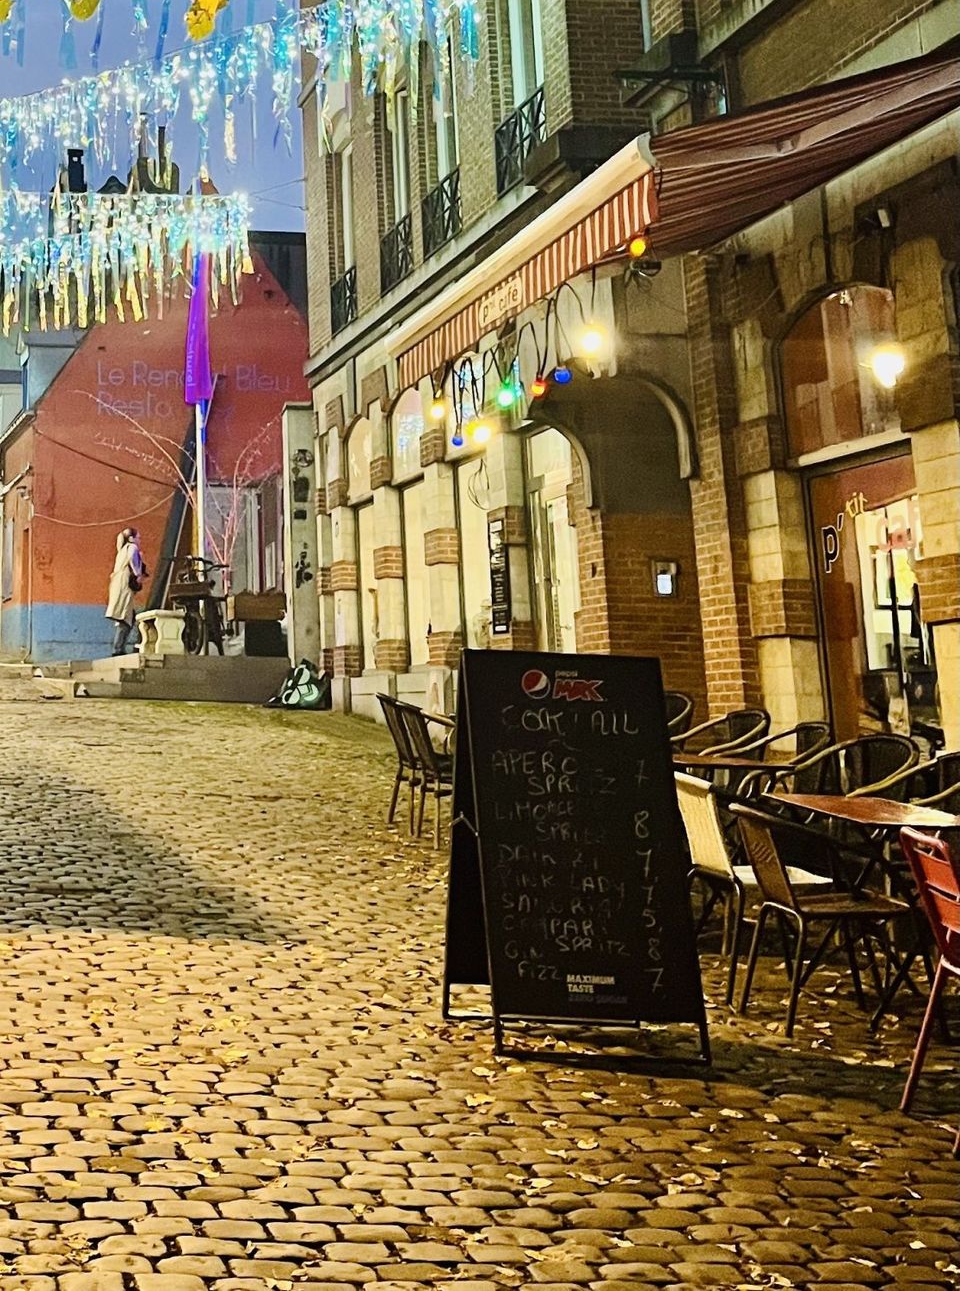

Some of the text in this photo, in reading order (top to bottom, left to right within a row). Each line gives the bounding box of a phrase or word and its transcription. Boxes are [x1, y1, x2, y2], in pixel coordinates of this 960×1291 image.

[97, 360, 292, 393] Le Rend Bleu
[97, 390, 175, 418] Resto
[633, 810, 651, 839] 8
[647, 937, 662, 961] 8
[566, 974, 616, 985] MAXIMUM
[566, 984, 595, 994] TASTE
